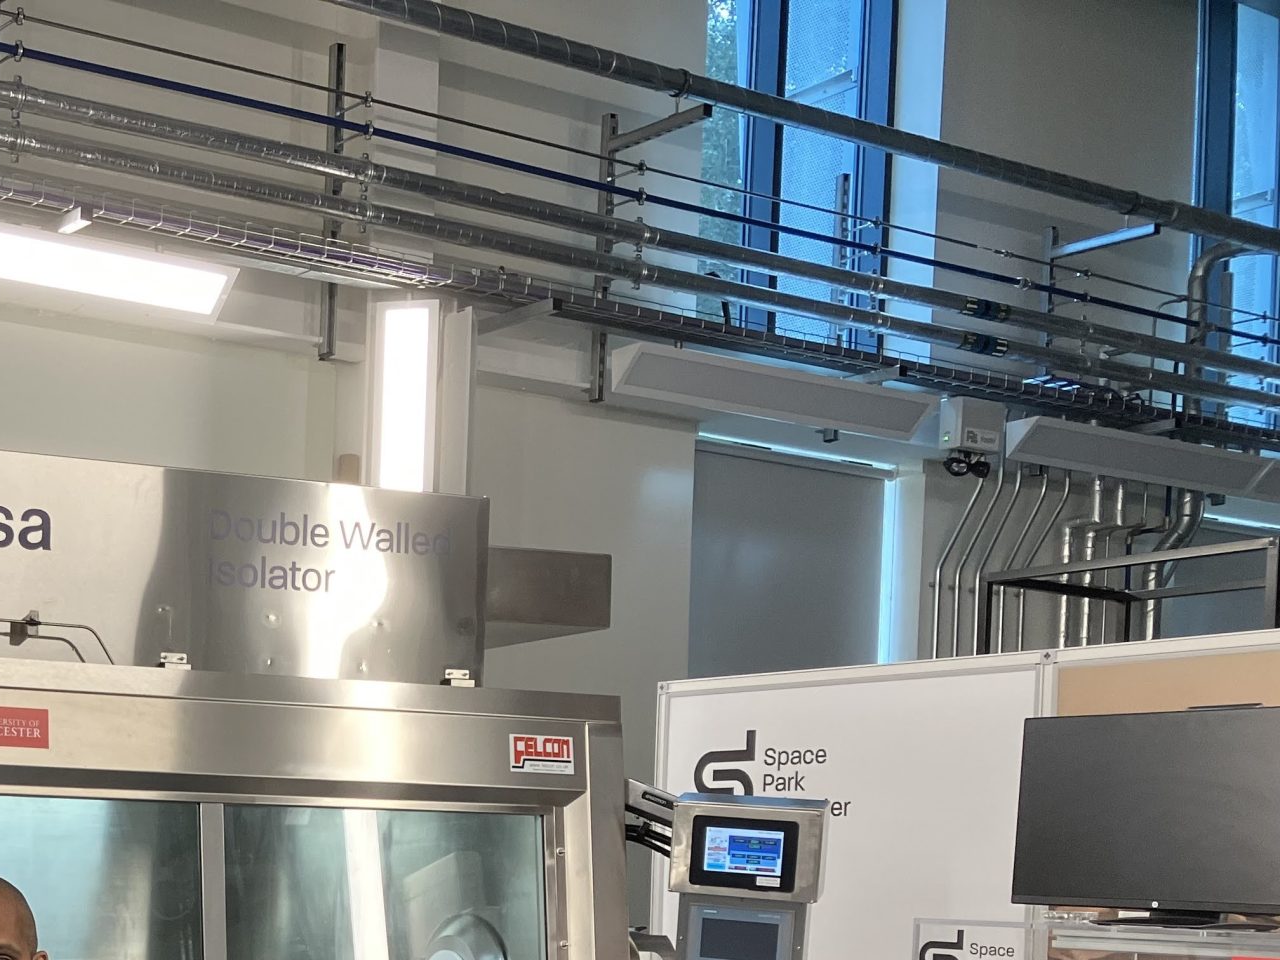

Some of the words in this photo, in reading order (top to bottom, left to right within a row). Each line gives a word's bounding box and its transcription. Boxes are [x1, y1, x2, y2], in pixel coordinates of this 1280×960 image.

[210, 508, 330, 548] Double
[339, 520, 451, 556] Walled
[208, 556, 336, 593] Isolator
[764, 747, 827, 771] Space
[763, 770, 805, 792] Park
[970, 943, 1015, 958] Space
